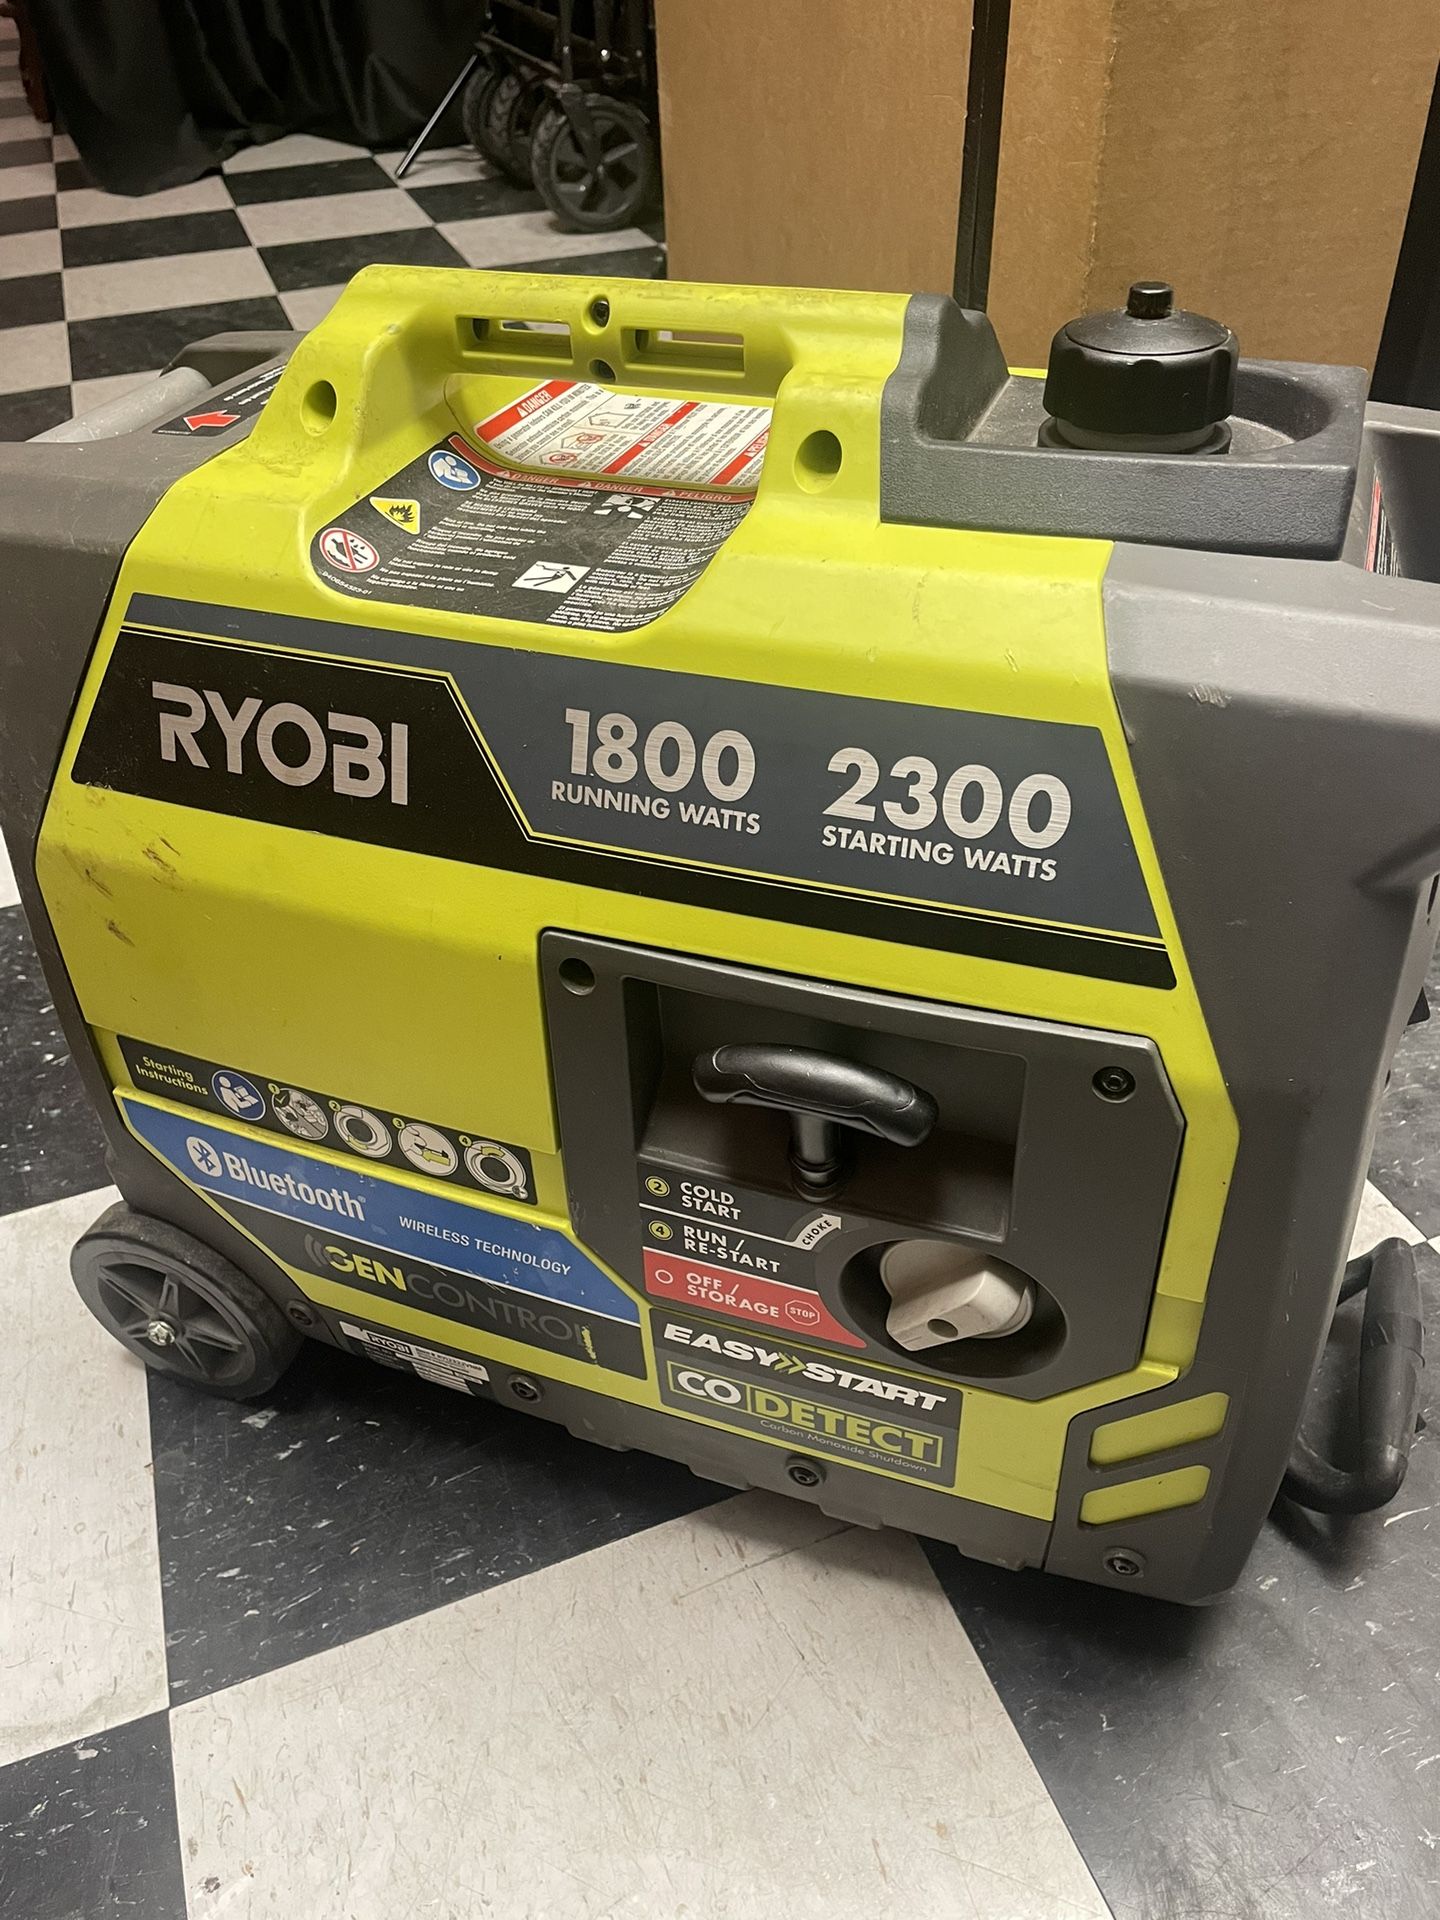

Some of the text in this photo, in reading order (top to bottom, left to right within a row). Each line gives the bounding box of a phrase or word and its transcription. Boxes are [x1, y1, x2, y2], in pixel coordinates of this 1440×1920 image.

[521, 390, 553, 413] DANGER
[512, 473, 560, 484] DANGER
[595, 484, 644, 493] DANGER
[679, 490, 732, 501] PELIGRO
[152, 680, 409, 806] RYOBI
[565, 708, 756, 802] 1800
[551, 781, 761, 835] RUNNING WATTS
[822, 747, 1072, 849] 2300
[821, 824, 1058, 882] STARTING WATTS
[135, 1064, 209, 1096] Instructions
[142, 1056, 194, 1083] Starting
[679, 1181, 735, 1205] COLD
[680, 1195, 741, 1221] START
[399, 1215, 572, 1276] WIRELESS TECHNOLOGY
[683, 1225, 727, 1247] RUN
[801, 1219, 833, 1246] CHOKE
[684, 1238, 781, 1273] RE-START
[686, 1272, 723, 1290] OFF
[687, 1285, 780, 1318] STORAGE
[789, 1305, 817, 1320] STOP
[371, 1334, 410, 1355] RYOBI
[663, 1323, 947, 1411] EASY START
[677, 1370, 934, 1460] CO DETECT
[759, 1419, 928, 1473] Carbon Monoxide Shutdown
